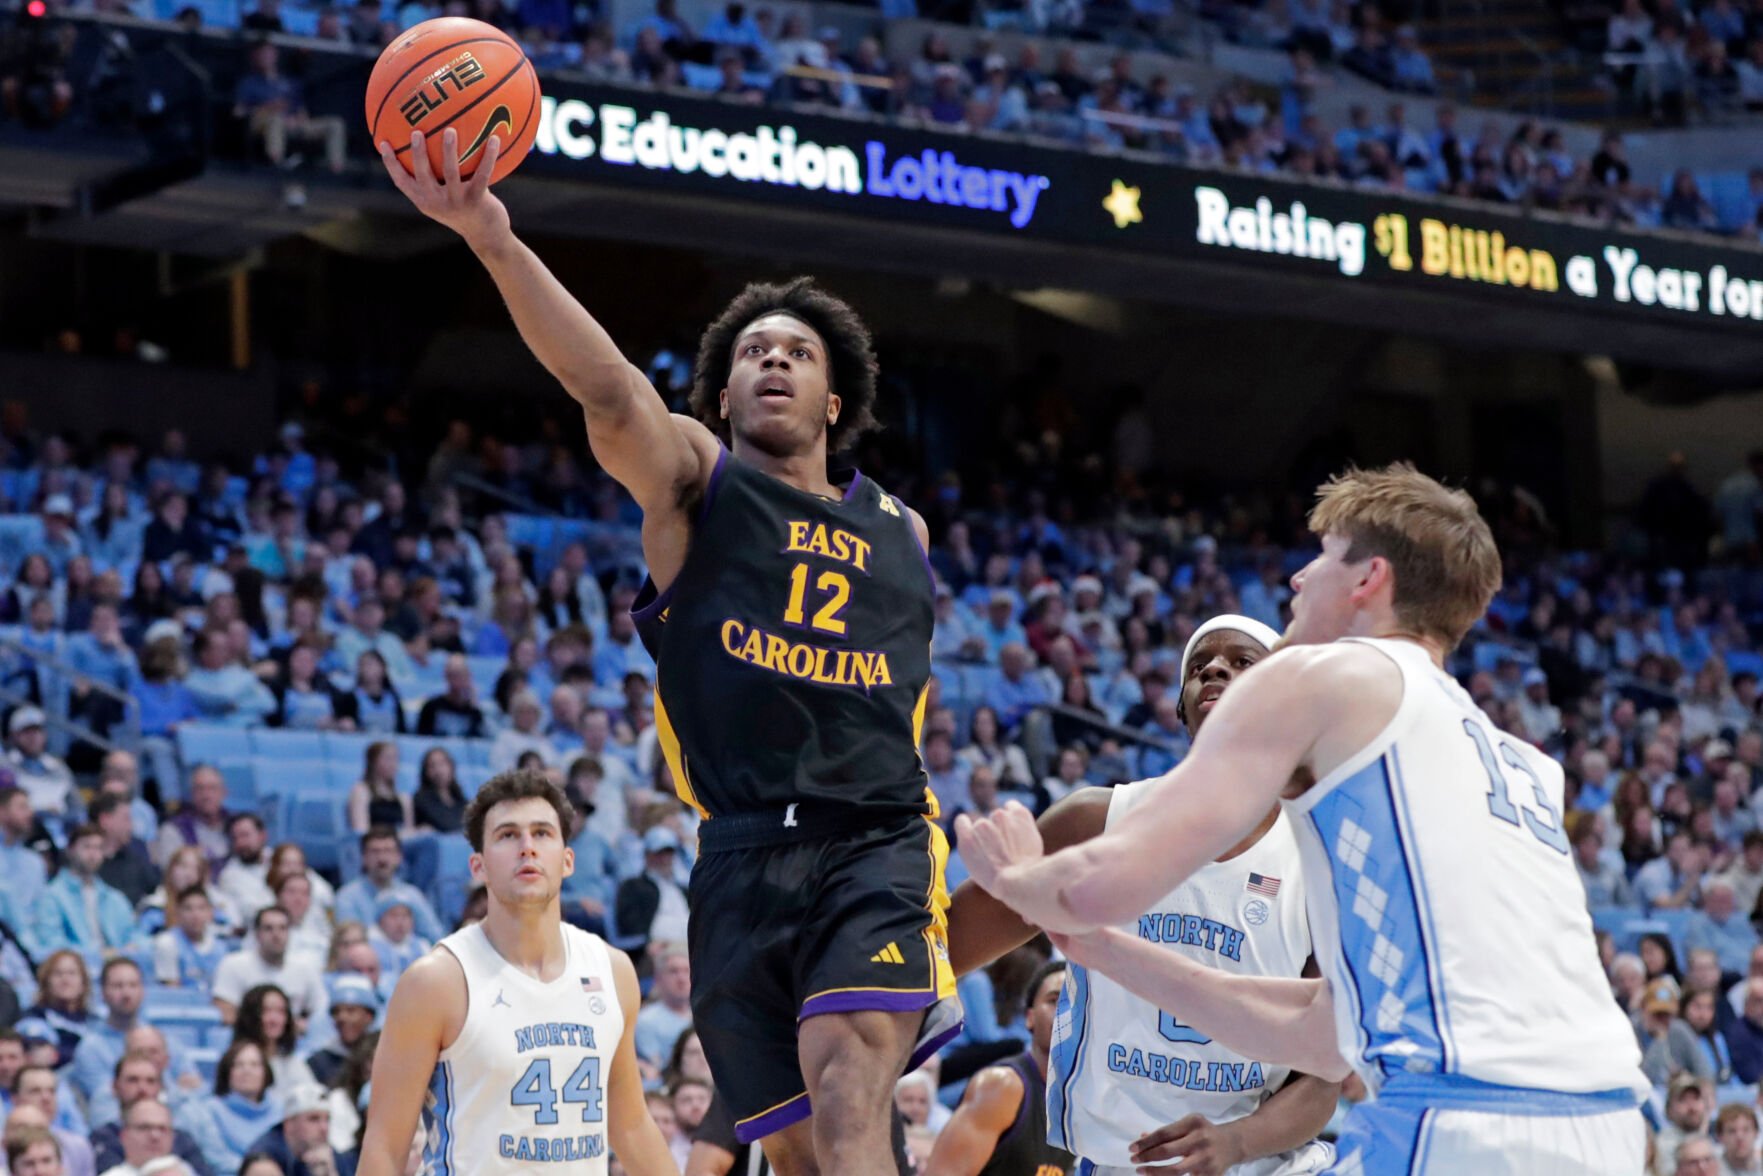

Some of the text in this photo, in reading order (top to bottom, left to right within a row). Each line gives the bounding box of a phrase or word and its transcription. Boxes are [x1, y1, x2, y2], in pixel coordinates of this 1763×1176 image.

[399, 57, 486, 127] ELITE
[599, 103, 862, 194] Education
[865, 141, 1042, 229] Lottery
[1194, 186, 1366, 276] Raising
[1373, 212, 1412, 272] $1
[1420, 218, 1559, 292] Billion
[1565, 254, 1598, 298] a
[1603, 245, 1702, 312] Year
[784, 520, 871, 574] EAST
[783, 562, 851, 636] 12
[720, 618, 894, 690] CAROLINA
[1462, 718, 1568, 856] 13
[1138, 913, 1244, 962] NORTH
[515, 1022, 597, 1053] NORTH
[1107, 1042, 1265, 1093] CAROLINA
[511, 1057, 603, 1125] 44
[499, 1133, 604, 1162] CAROLIN
